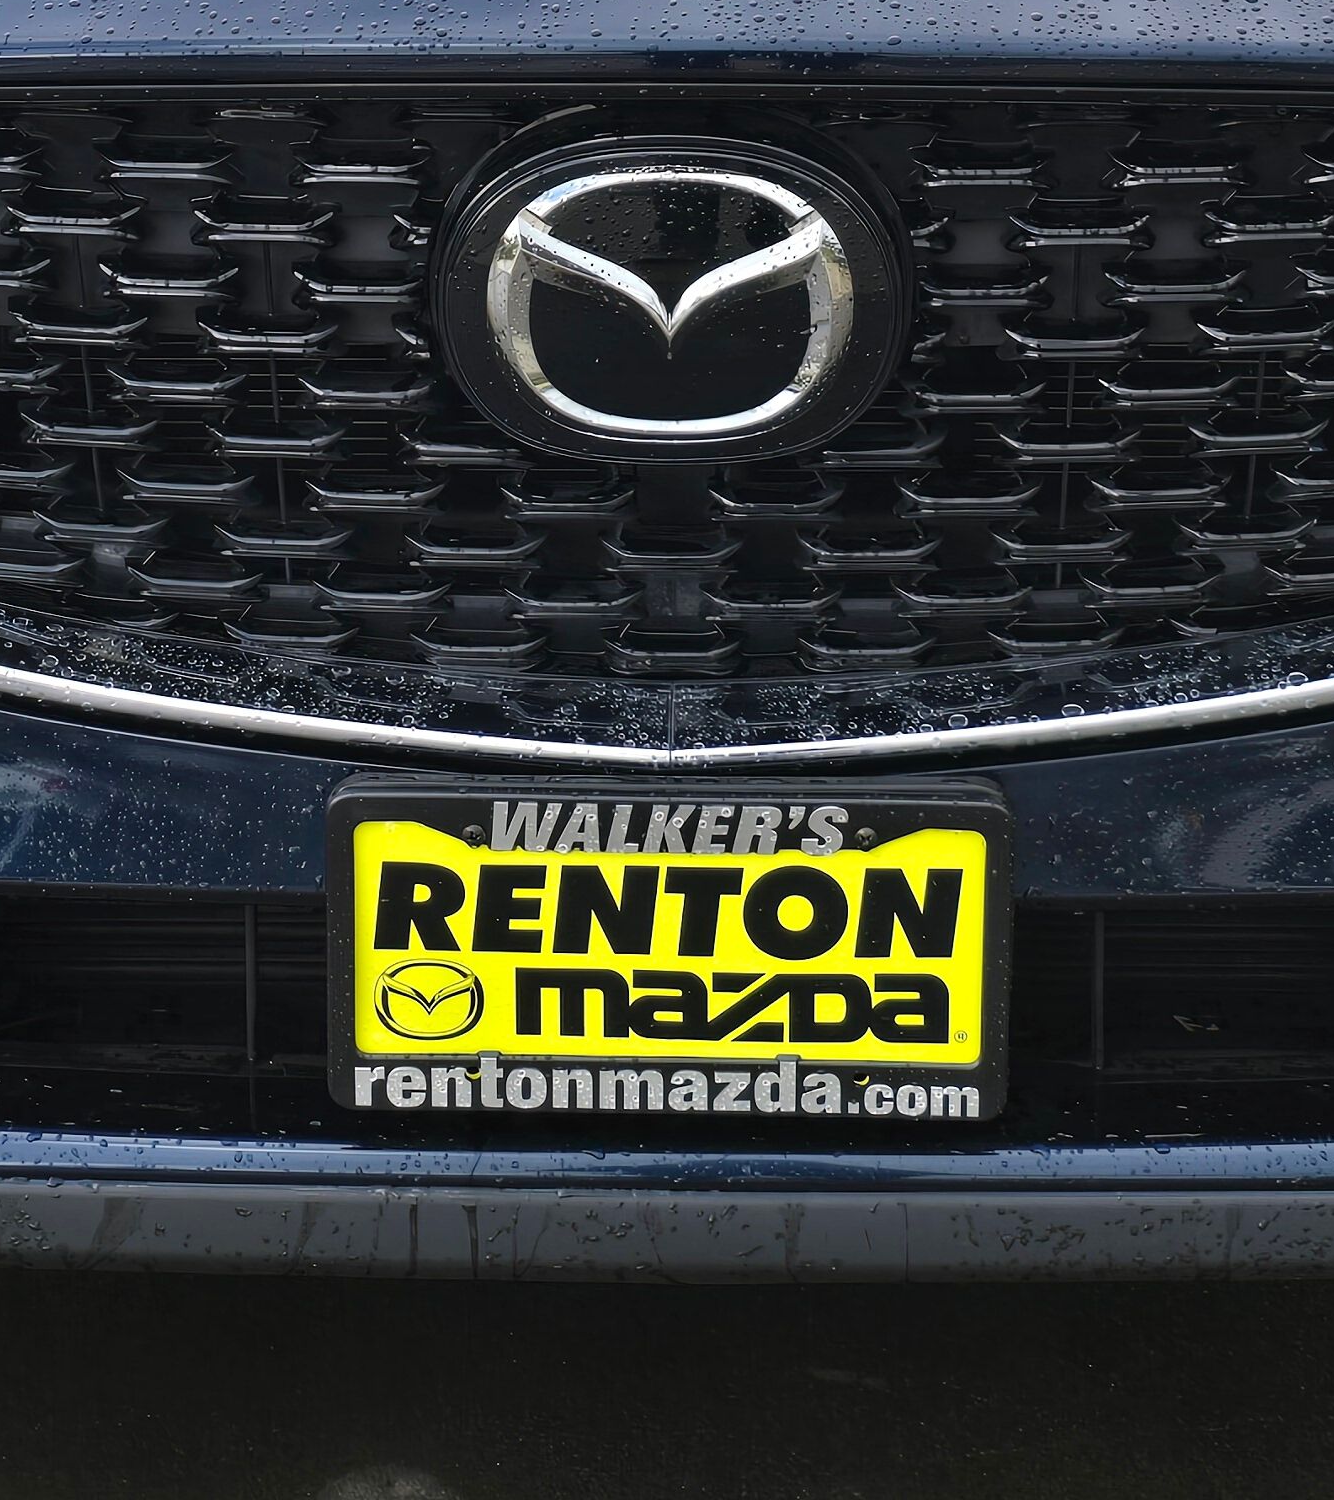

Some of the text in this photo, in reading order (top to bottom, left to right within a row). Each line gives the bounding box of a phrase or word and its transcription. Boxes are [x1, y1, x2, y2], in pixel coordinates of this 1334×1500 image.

[490, 800, 850, 854] WALKER'S
[373, 861, 964, 961] RENTON
[515, 967, 949, 1043] mazda
[354, 1056, 981, 1119] rentonmazda.com
